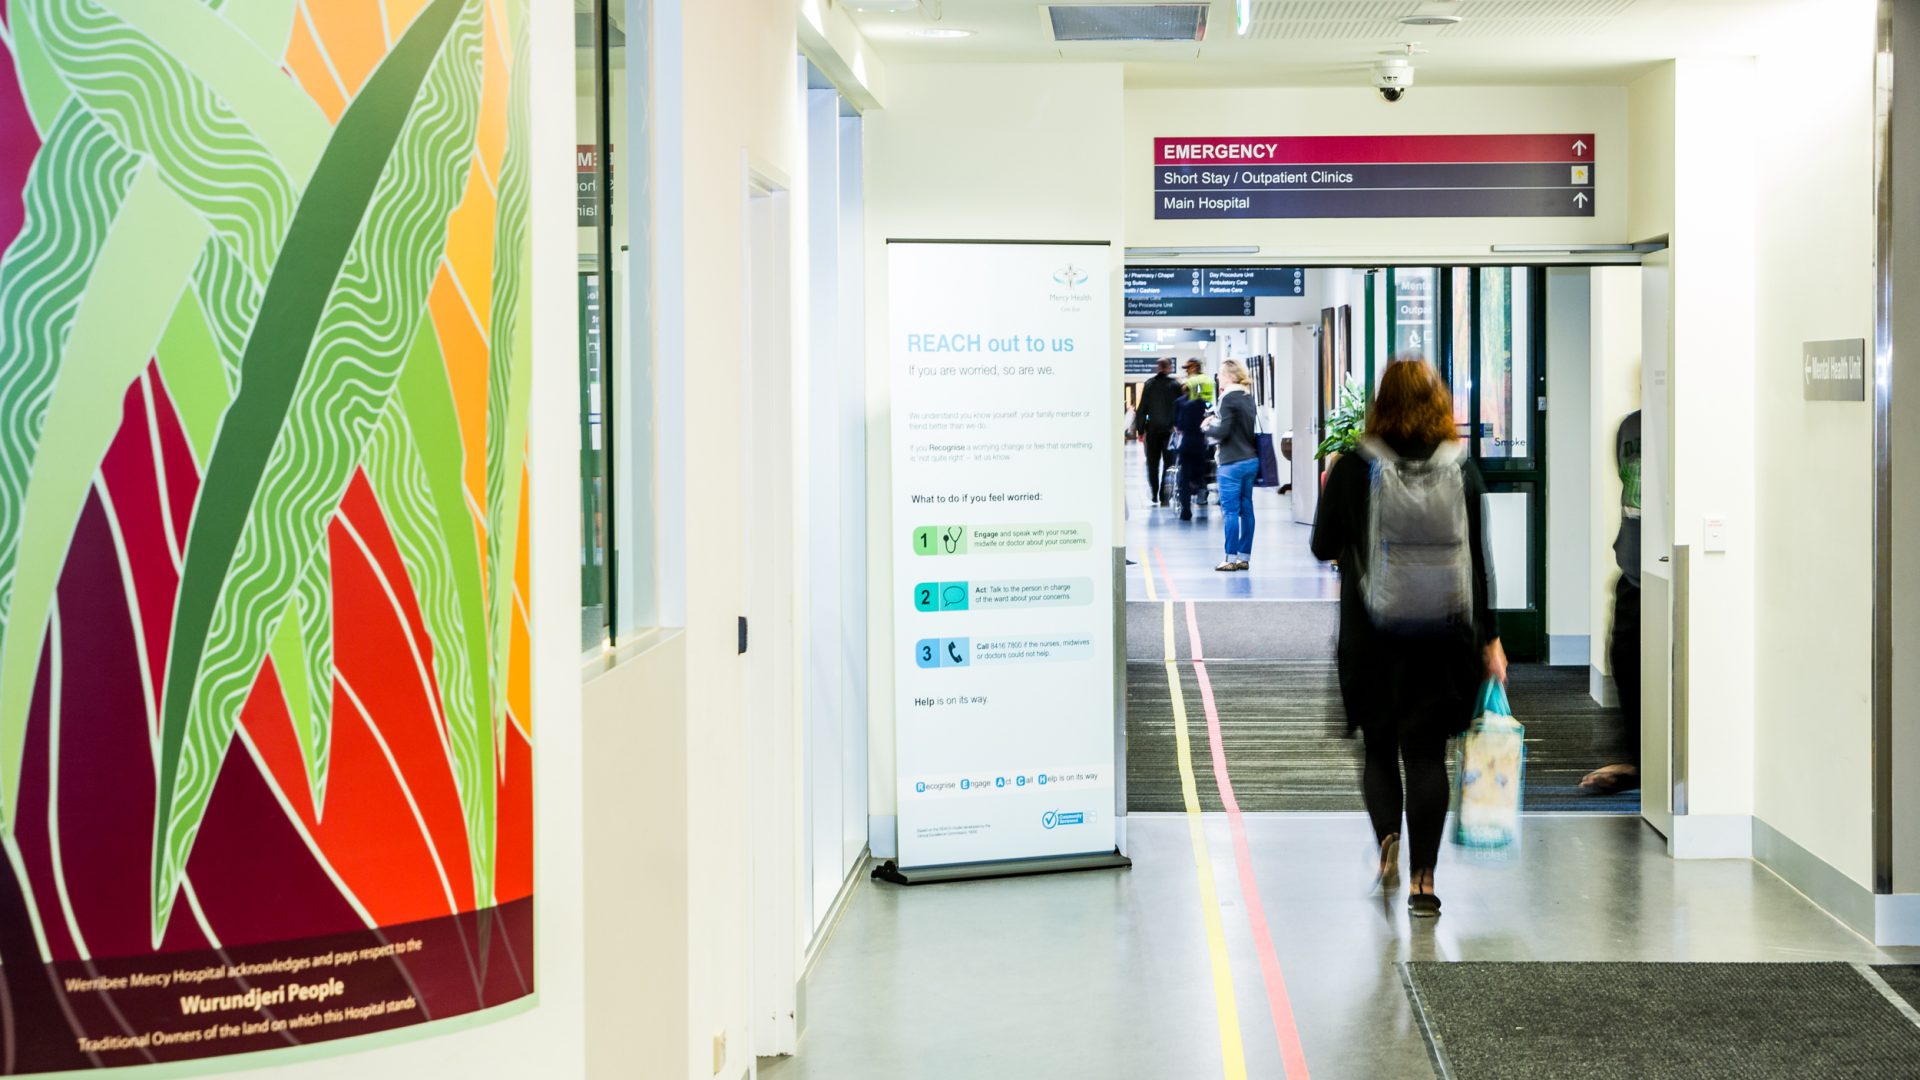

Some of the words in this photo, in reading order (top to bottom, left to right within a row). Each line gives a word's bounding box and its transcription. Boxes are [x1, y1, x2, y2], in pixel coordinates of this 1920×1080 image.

[1164, 144, 1278, 159] EMERGENCY
[1164, 172, 1198, 184] Short
[1202, 172, 1230, 186] Stay
[1233, 172, 1238, 184] /
[1242, 171, 1308, 186] Outpatient
[1311, 170, 1353, 183] Clinics
[1164, 197, 1194, 209] Main
[1198, 196, 1250, 212] Hospital
[1050, 294, 1070, 303] Mercy
[908, 334, 980, 352] REACH
[988, 335, 1020, 352] out
[1026, 335, 1045, 352] to
[1052, 338, 1074, 352] us
[909, 365, 915, 376] If
[918, 367, 936, 378] you
[940, 367, 956, 376] are
[959, 365, 1000, 376] worried,
[1003, 366, 1016, 375] so
[1018, 366, 1034, 375] are
[1036, 366, 1055, 375] we.
[1812, 356, 1830, 380] Mental
[1830, 356, 1848, 380] Health
[1849, 355, 1861, 380] Unit
[974, 411, 990, 419] know
[929, 443, 965, 452] Recognise
[972, 444, 1000, 452] worrying
[1001, 443, 1024, 452] change
[1060, 442, 1092, 451] something
[912, 494, 934, 503] What
[937, 494, 946, 503] to
[948, 494, 959, 503] do
[962, 494, 968, 502] if
[970, 495, 986, 504] you
[989, 493, 1004, 501] feel
[920, 533, 927, 548] 1
[974, 531, 998, 539] Engage
[921, 590, 930, 604] 2
[923, 646, 932, 661] 3
[914, 697, 934, 708] Help
[960, 696, 968, 704] its
[917, 782, 956, 792] Recognise
[961, 779, 990, 790] Engage
[996, 777, 1011, 787] Act
[1016, 776, 1033, 786] Call
[1038, 774, 1057, 784] Help
[65, 975, 128, 992] Werribee
[130, 972, 172, 988] Mercy
[172, 964, 226, 984] Hospital
[228, 958, 310, 977] acknowledges
[312, 951, 333, 967] and
[334, 950, 358, 966] pays
[360, 944, 395, 959] respect
[395, 942, 405, 954] to
[406, 938, 423, 951] the
[180, 984, 285, 1015] Wurundjeri
[288, 977, 345, 1002] People
[77, 1033, 150, 1052] Traditional
[152, 1028, 201, 1046] Owners
[204, 1024, 217, 1040] of
[219, 1022, 240, 1037] the
[242, 1020, 269, 1035] land
[271, 1018, 288, 1032] on
[288, 1012, 322, 1029] which
[323, 1009, 344, 1024] this
[345, 1001, 385, 1021] Hospital
[386, 995, 416, 1013] stands
